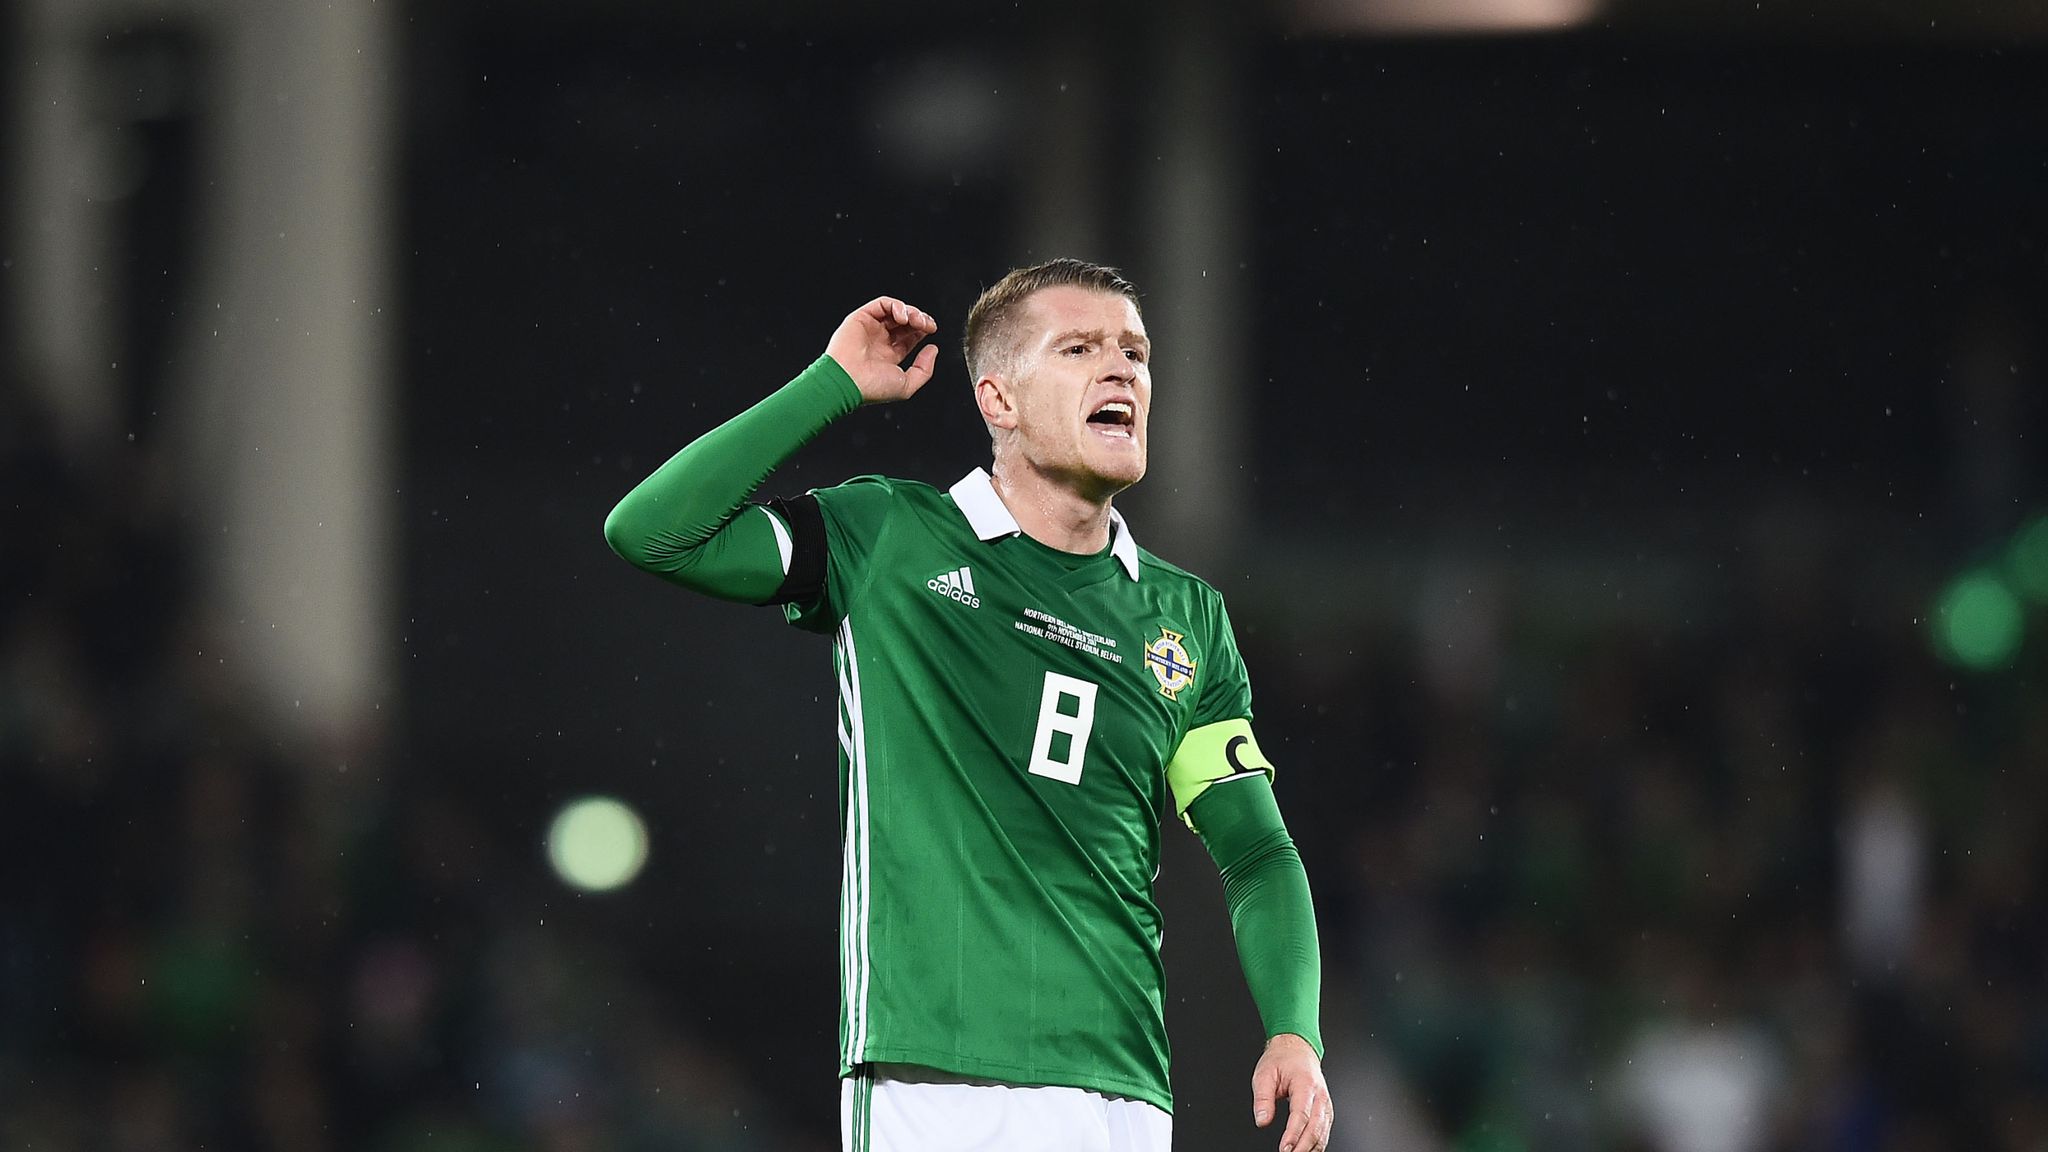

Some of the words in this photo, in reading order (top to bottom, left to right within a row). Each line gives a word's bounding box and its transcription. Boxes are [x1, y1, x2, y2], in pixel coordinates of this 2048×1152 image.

[928, 578, 980, 609] adidas
[1024, 607, 1056, 624] NORTHERN
[1015, 621, 1044, 638] NATIONAL
[1044, 630, 1074, 648] FOOTBALL
[1100, 649, 1122, 664] BELFAST
[1028, 670, 1098, 786] 8
